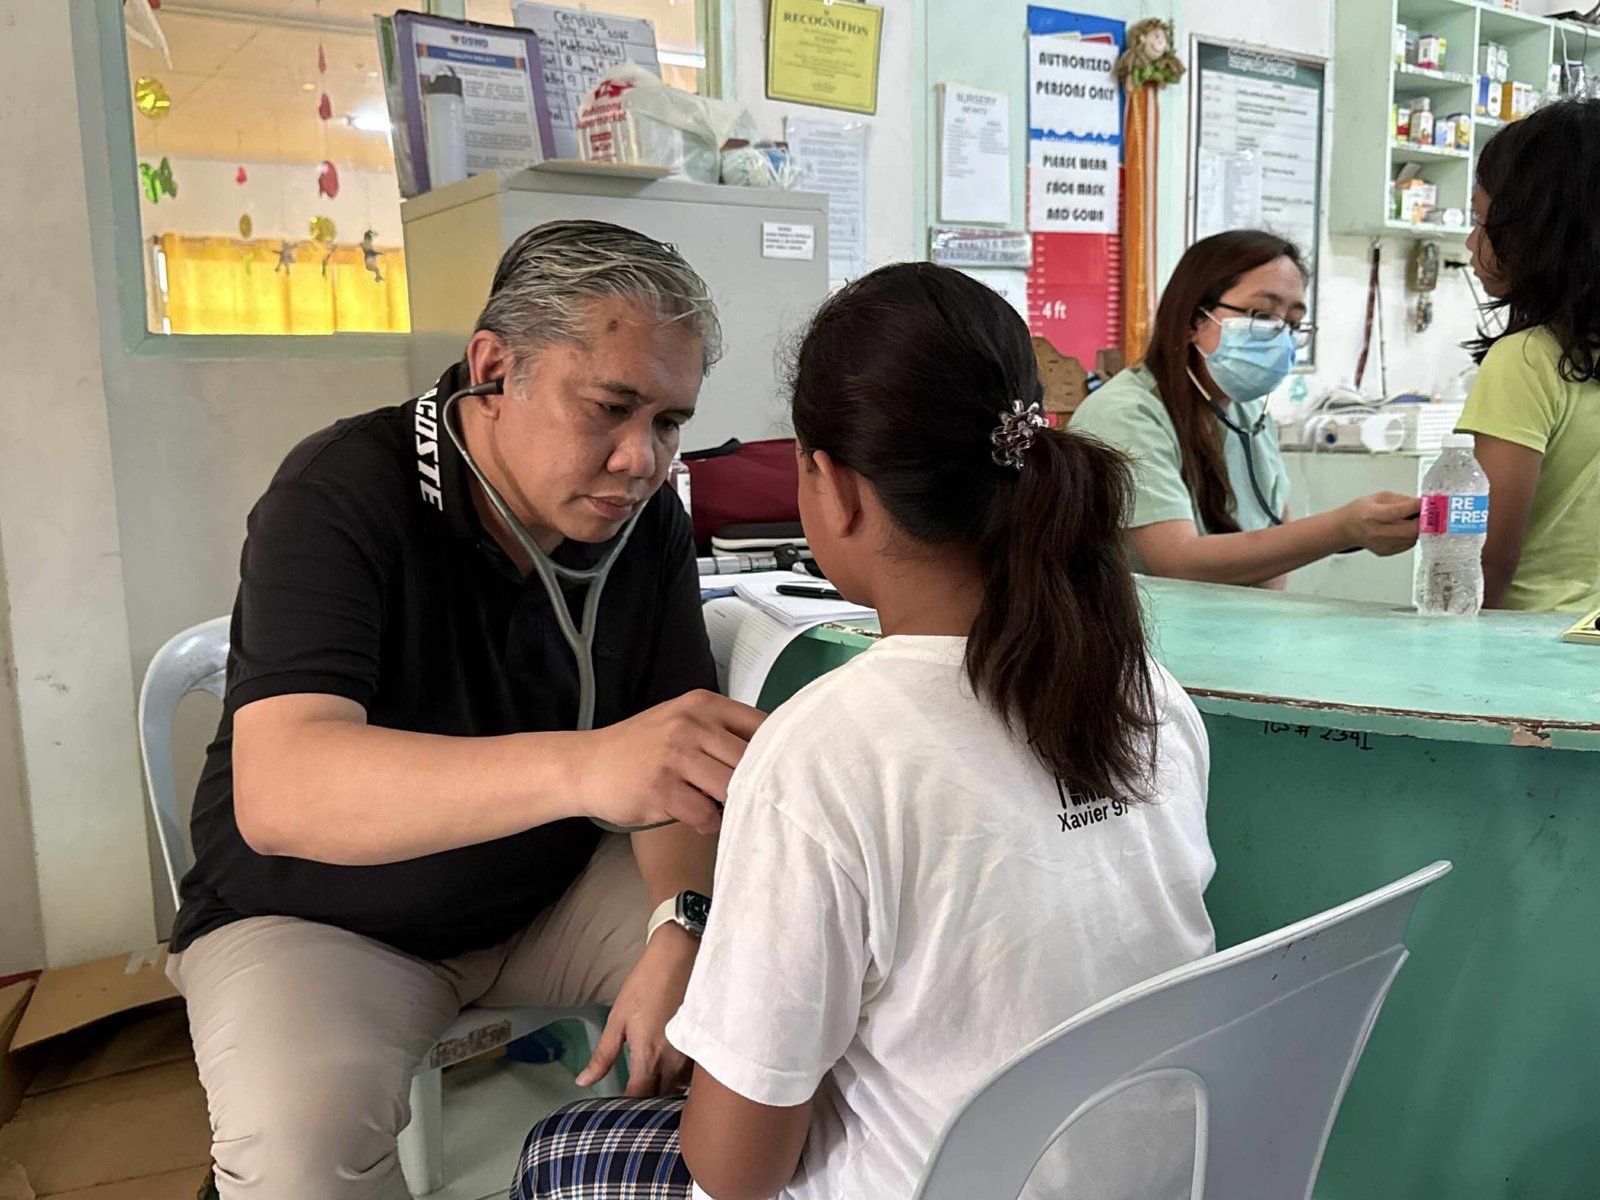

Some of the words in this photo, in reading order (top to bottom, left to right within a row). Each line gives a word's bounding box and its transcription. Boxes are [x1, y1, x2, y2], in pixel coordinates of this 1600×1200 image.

[553, 11, 607, 31] Census
[783, 12, 869, 37] RECOGNITION
[461, 36, 489, 49] DSWD
[1039, 52, 1112, 73] AUTHORIZED
[1036, 81, 1085, 99] PERSONS
[1088, 86, 1116, 101] ONLY
[1043, 155, 1076, 169] PLEASE
[1080, 158, 1107, 171] WEAR
[1046, 181, 1074, 195] FACE
[1077, 183, 1105, 196] MASK
[1046, 207, 1070, 221] AND
[1072, 208, 1104, 222] GOWN
[1042, 301, 1052, 319] 4
[1054, 300, 1066, 320] ft
[415, 379, 443, 511] ACOSTE
[1451, 497, 1475, 510] RE
[1057, 805, 1109, 832] Xavier
